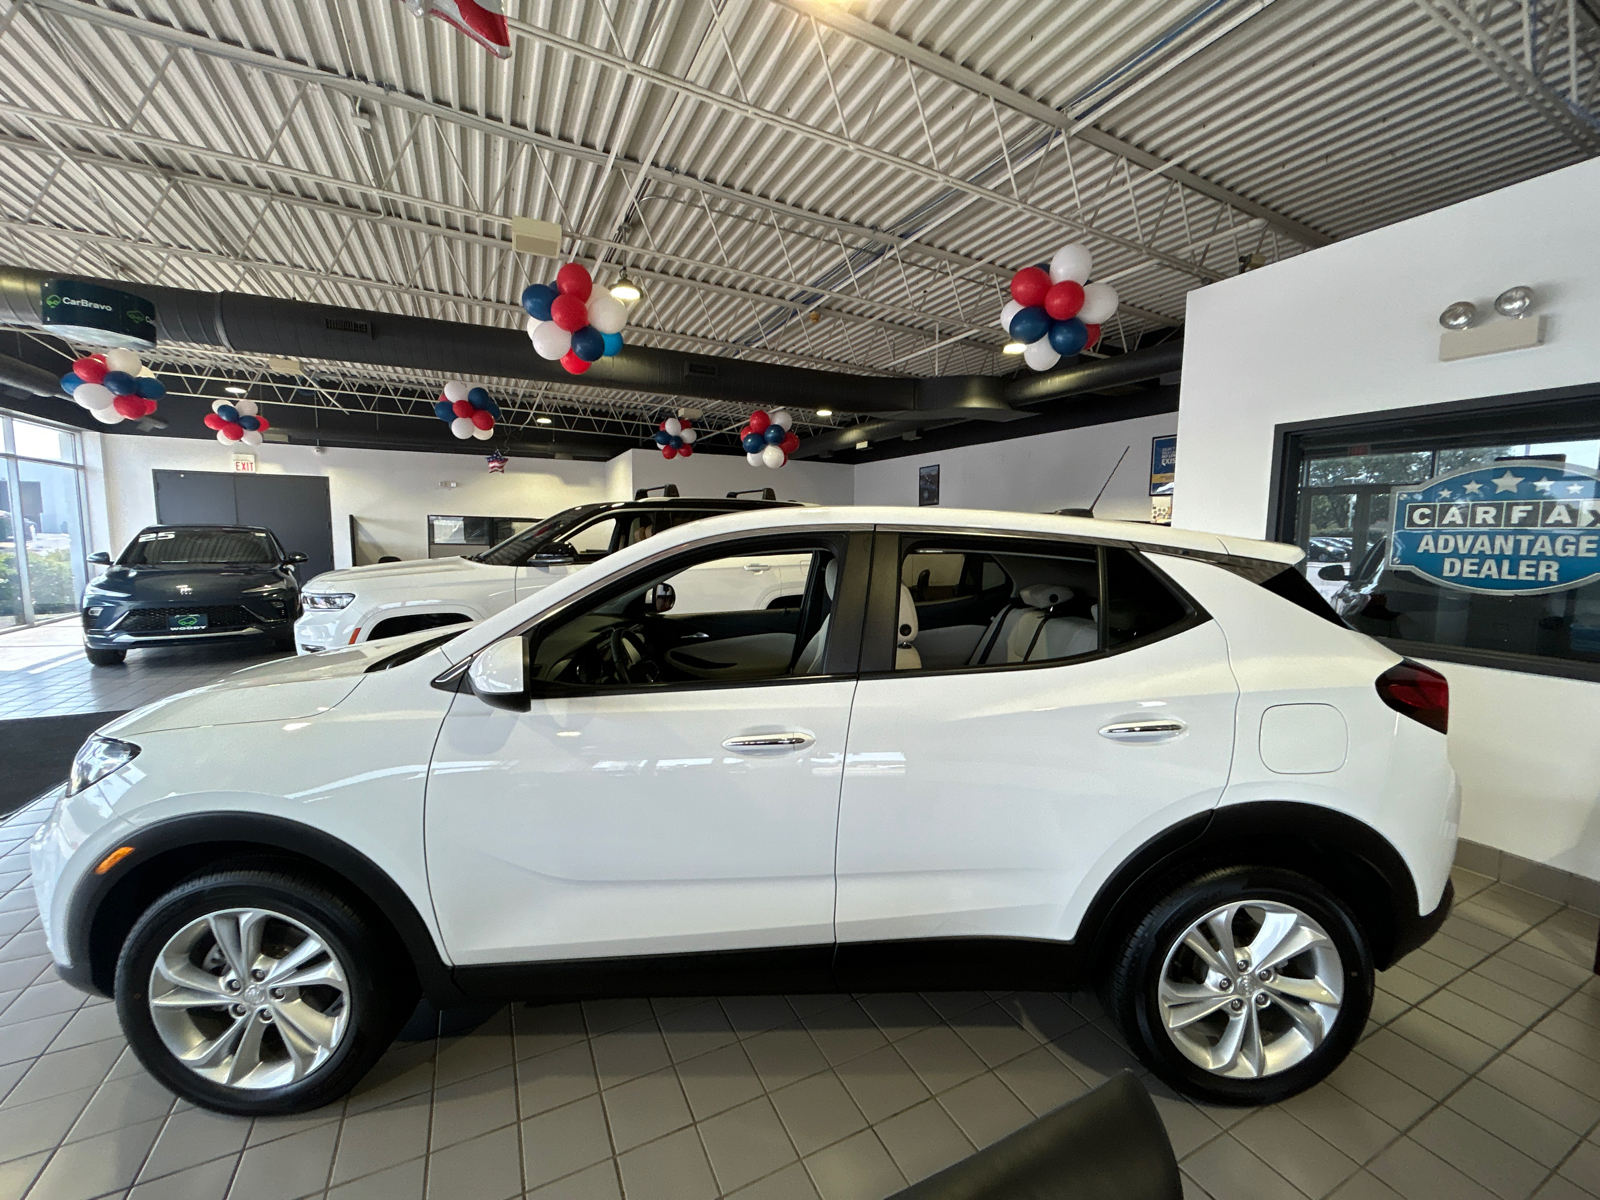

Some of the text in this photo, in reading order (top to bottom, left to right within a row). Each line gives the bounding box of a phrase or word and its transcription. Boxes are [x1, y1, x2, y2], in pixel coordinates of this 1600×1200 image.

[62, 297, 113, 312] CarBravo
[236, 461, 253, 471] EXIT
[138, 531, 176, 542] 25
[1417, 534, 1599, 557] ADVANTAGE
[1442, 557, 1560, 582] DEALER
